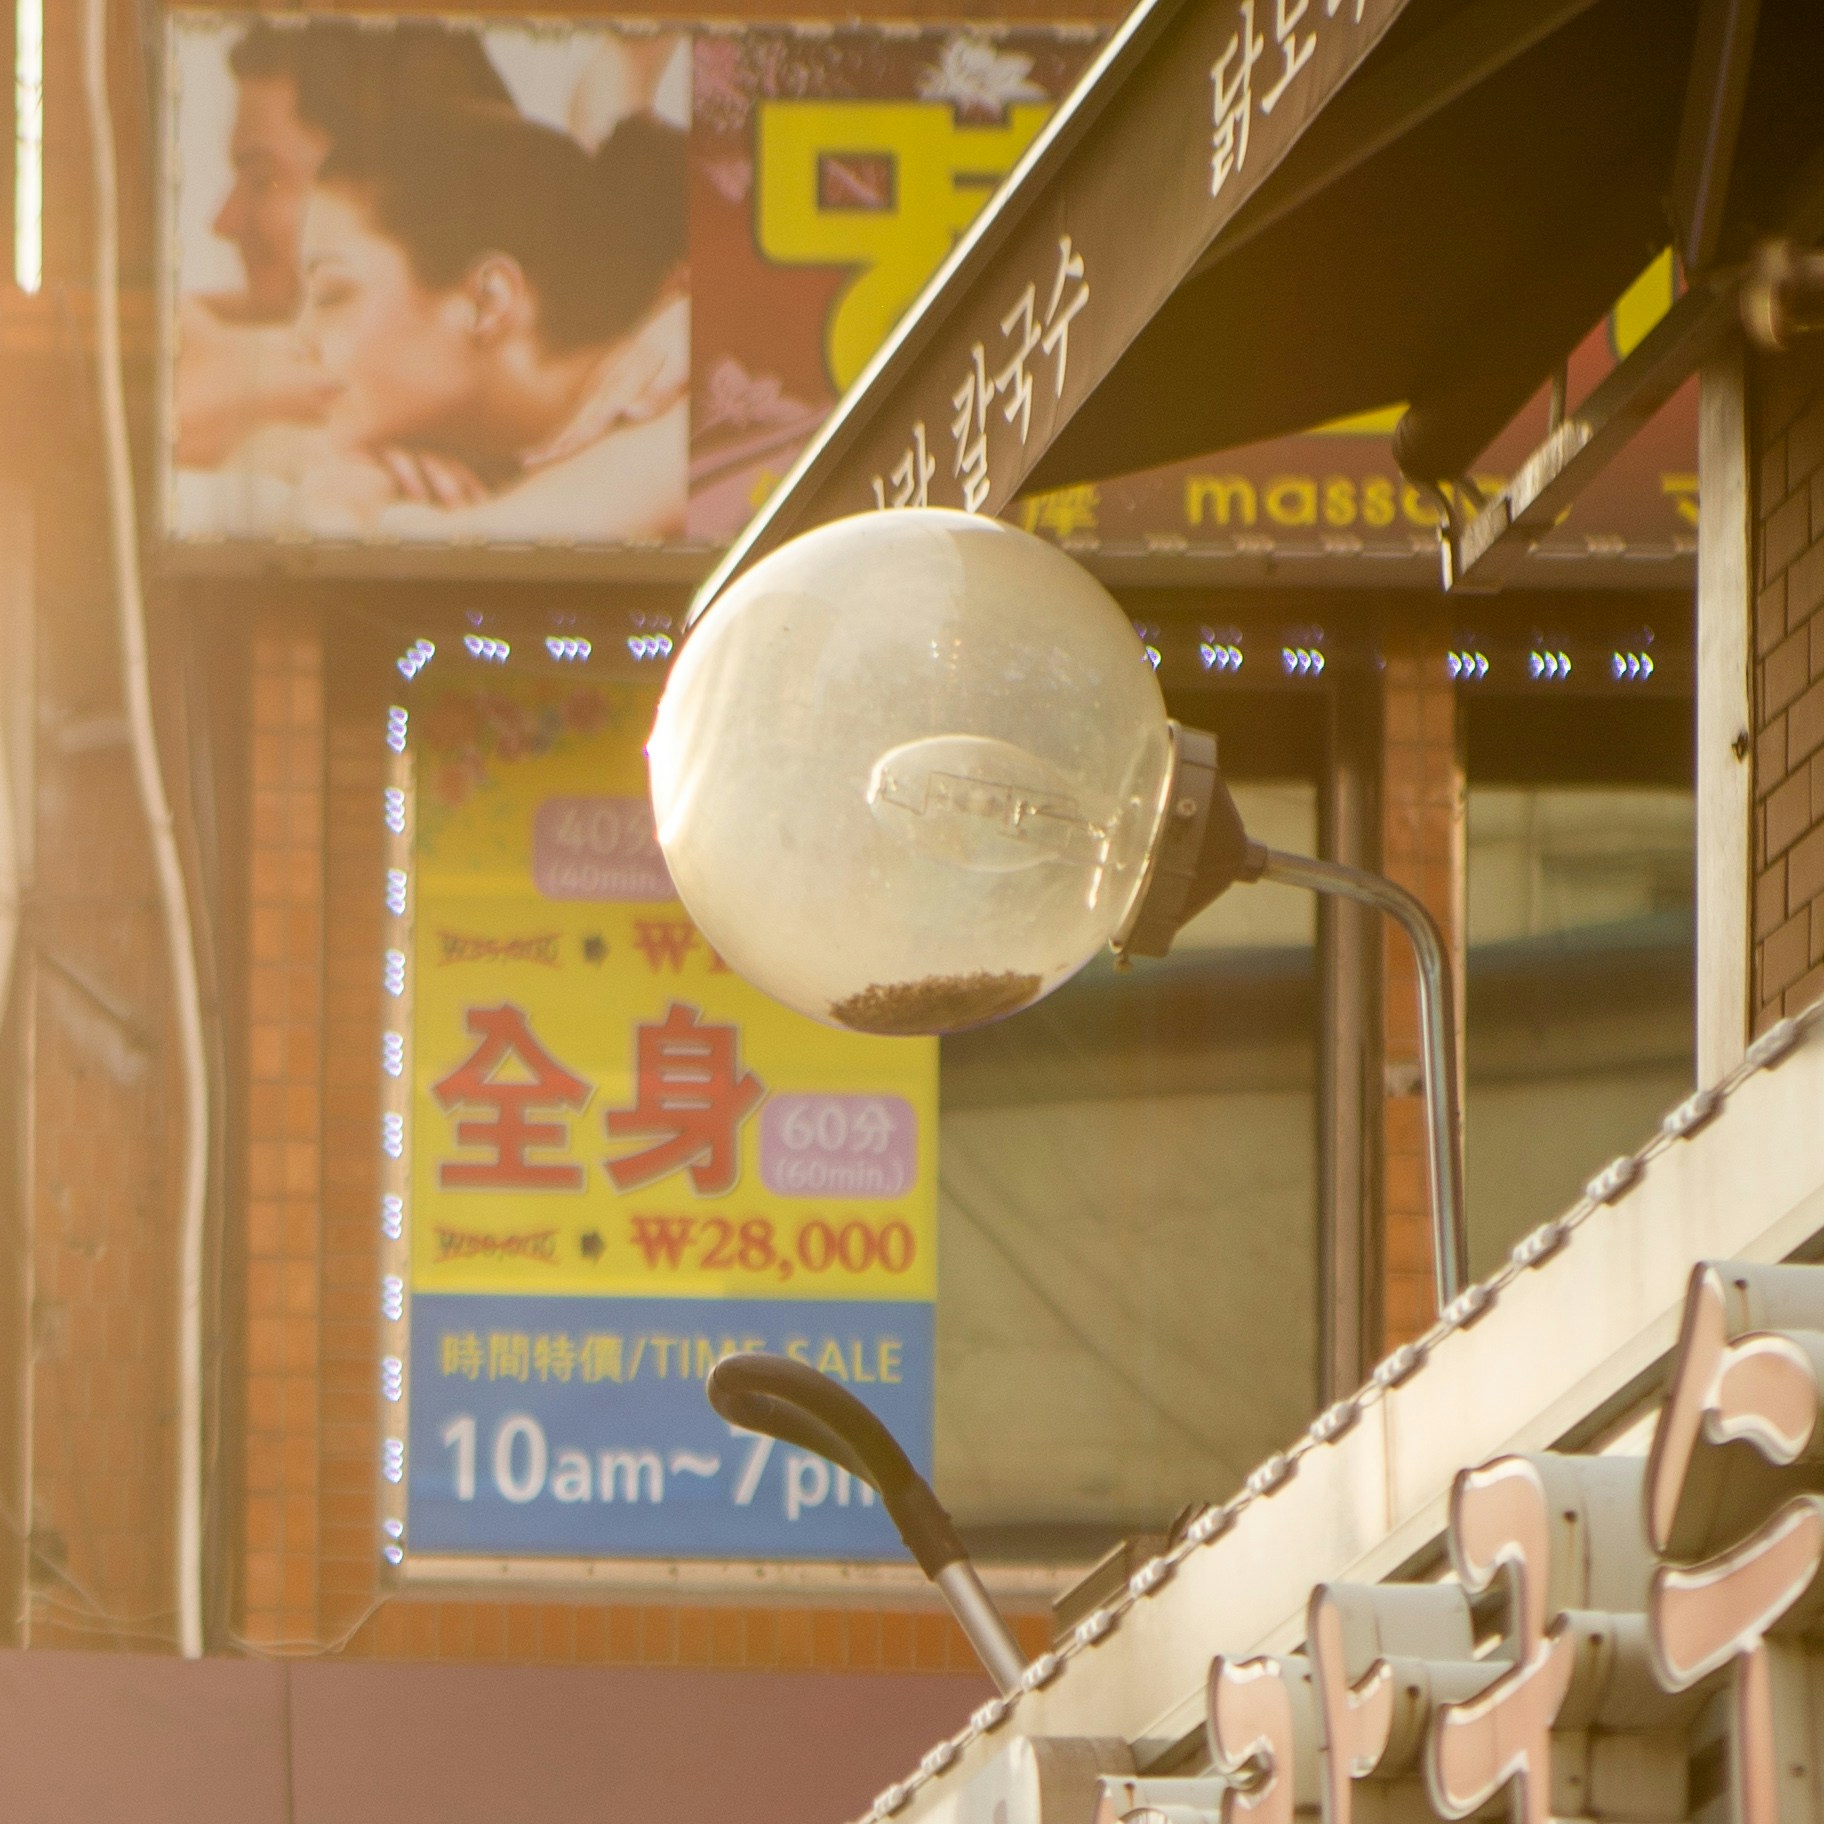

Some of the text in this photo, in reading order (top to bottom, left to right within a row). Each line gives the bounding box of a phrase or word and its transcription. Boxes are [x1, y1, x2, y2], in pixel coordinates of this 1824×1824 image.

[430, 1002, 772, 1196] 全身
[779, 1104, 898, 1155] 60分
[439, 1333, 768, 1384] 時間特價/TIM
